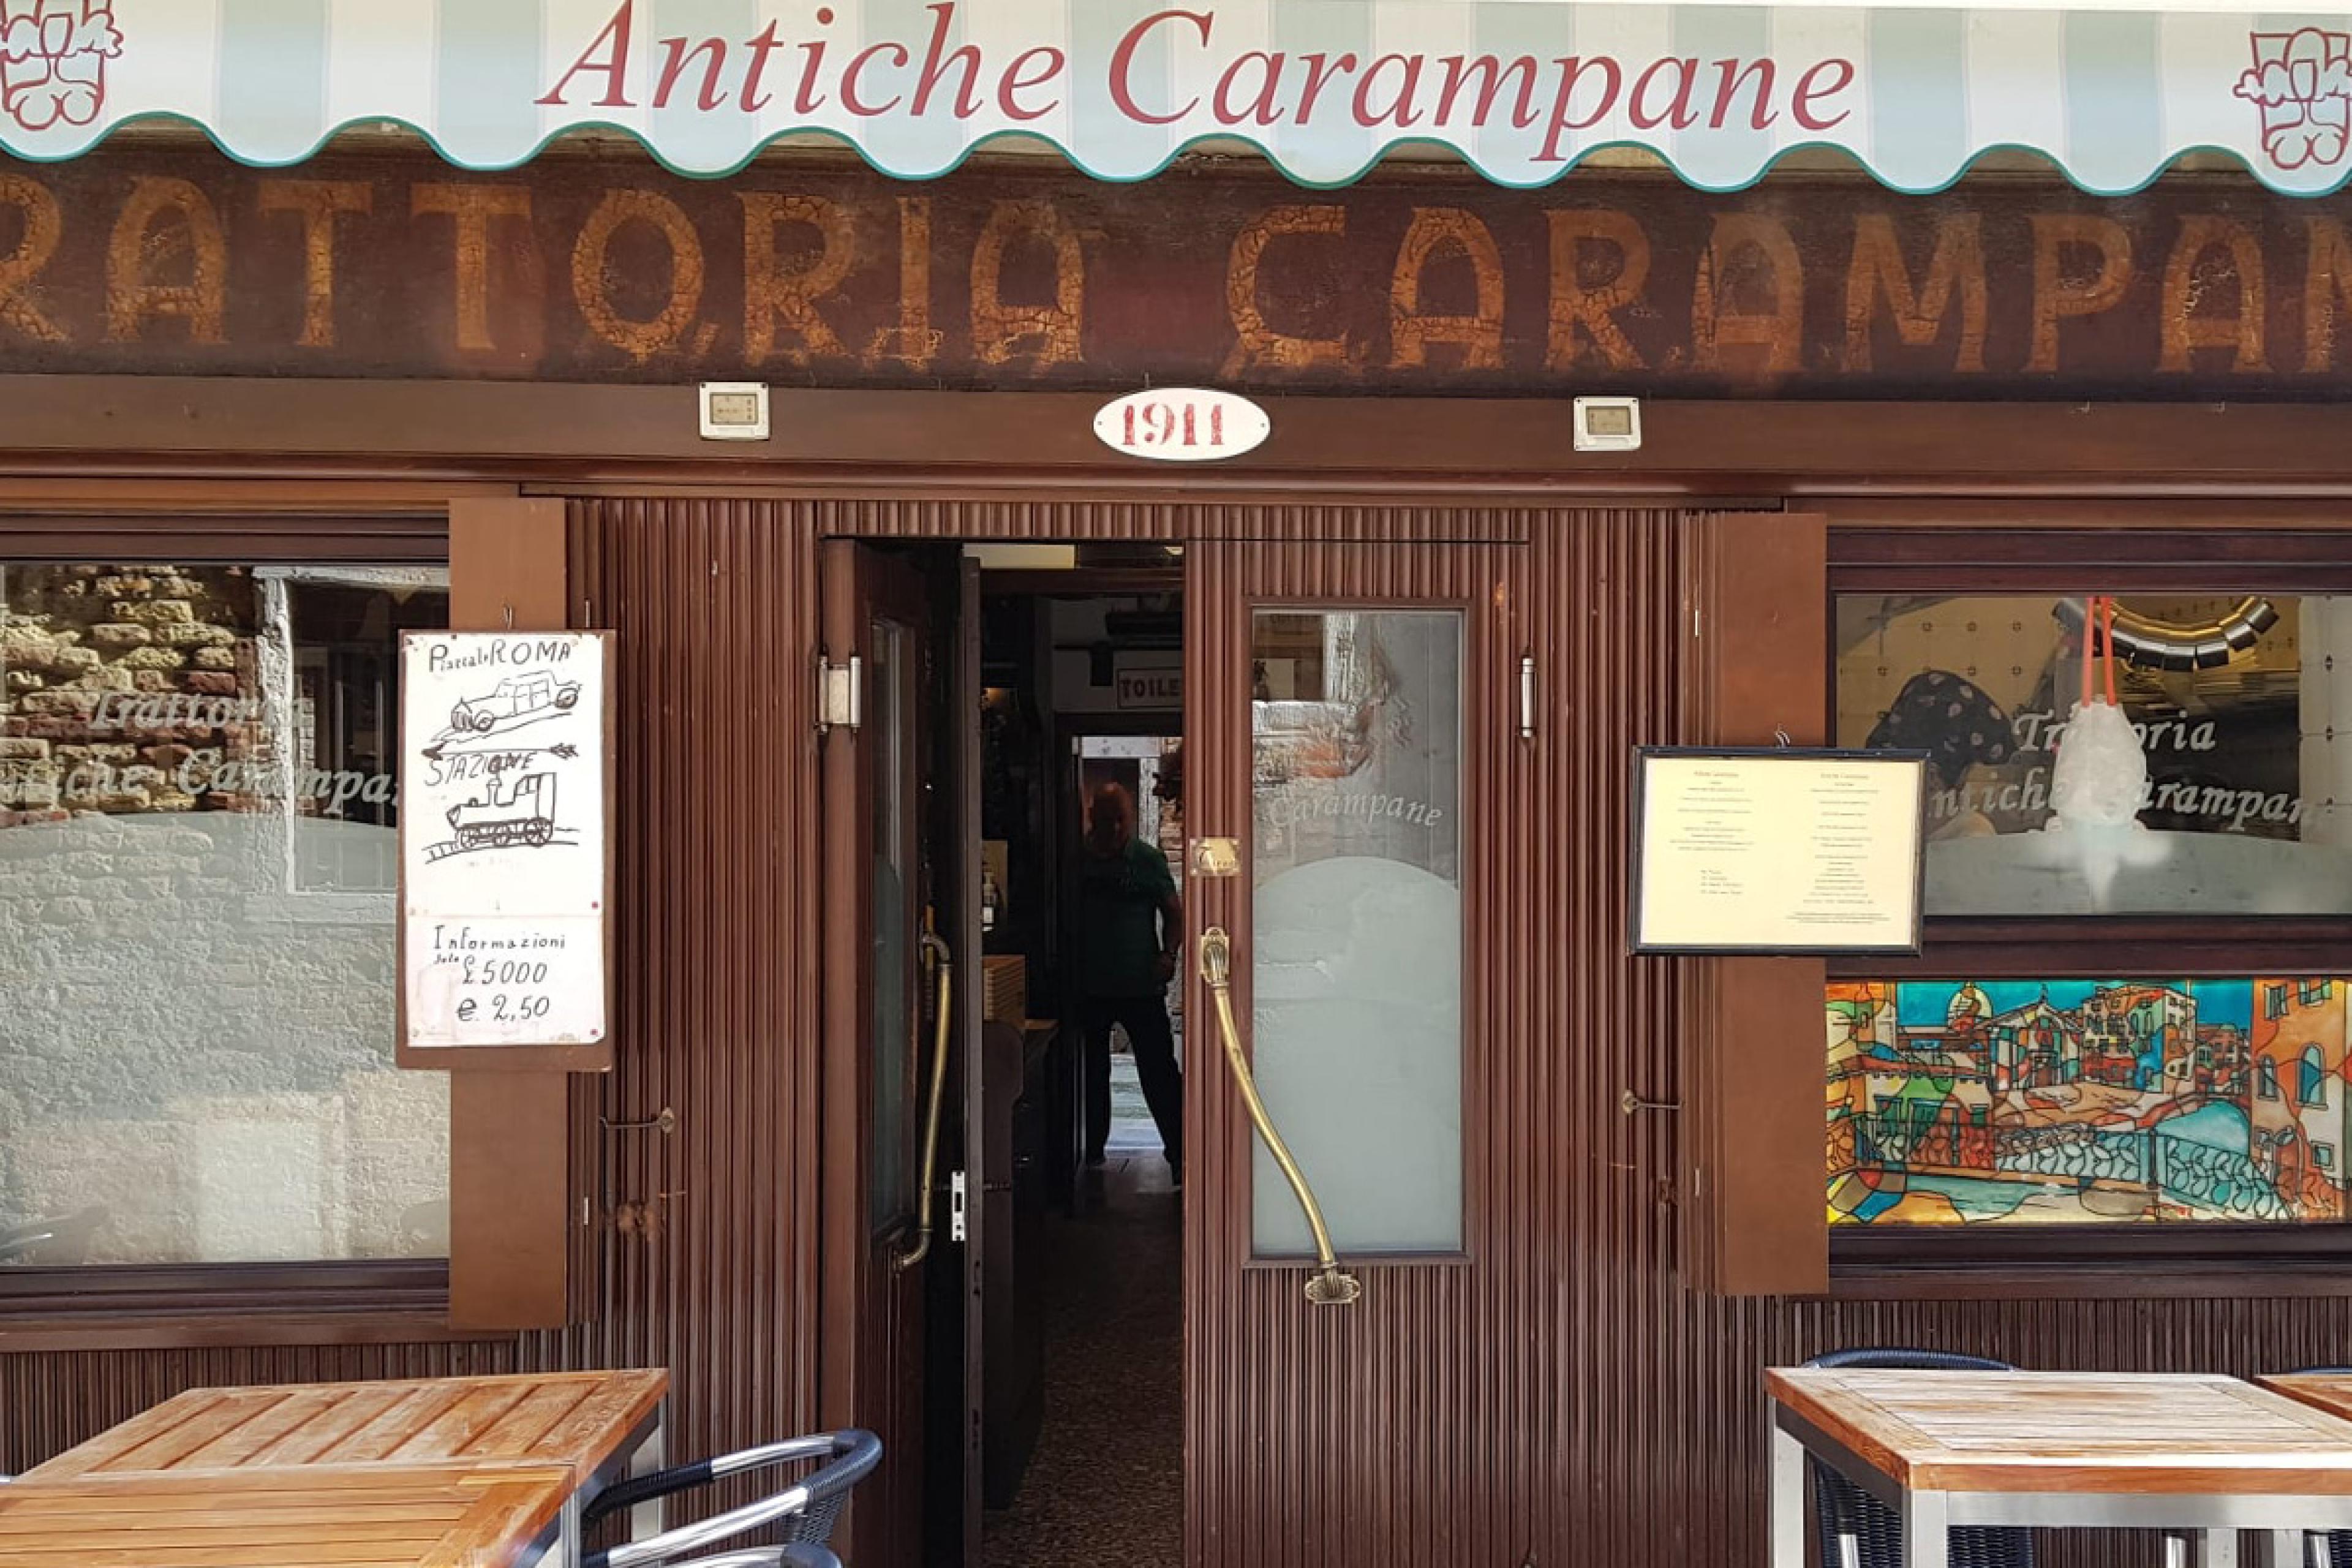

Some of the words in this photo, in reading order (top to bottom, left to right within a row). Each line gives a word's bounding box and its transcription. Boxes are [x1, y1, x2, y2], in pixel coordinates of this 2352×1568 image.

[532, 0, 1066, 121] Antiche
[1108, 9, 1855, 161] Carampane
[1122, 402, 1224, 451] 1911
[489, 638, 571, 667] ROMA
[434, 925, 565, 949] Informazioni
